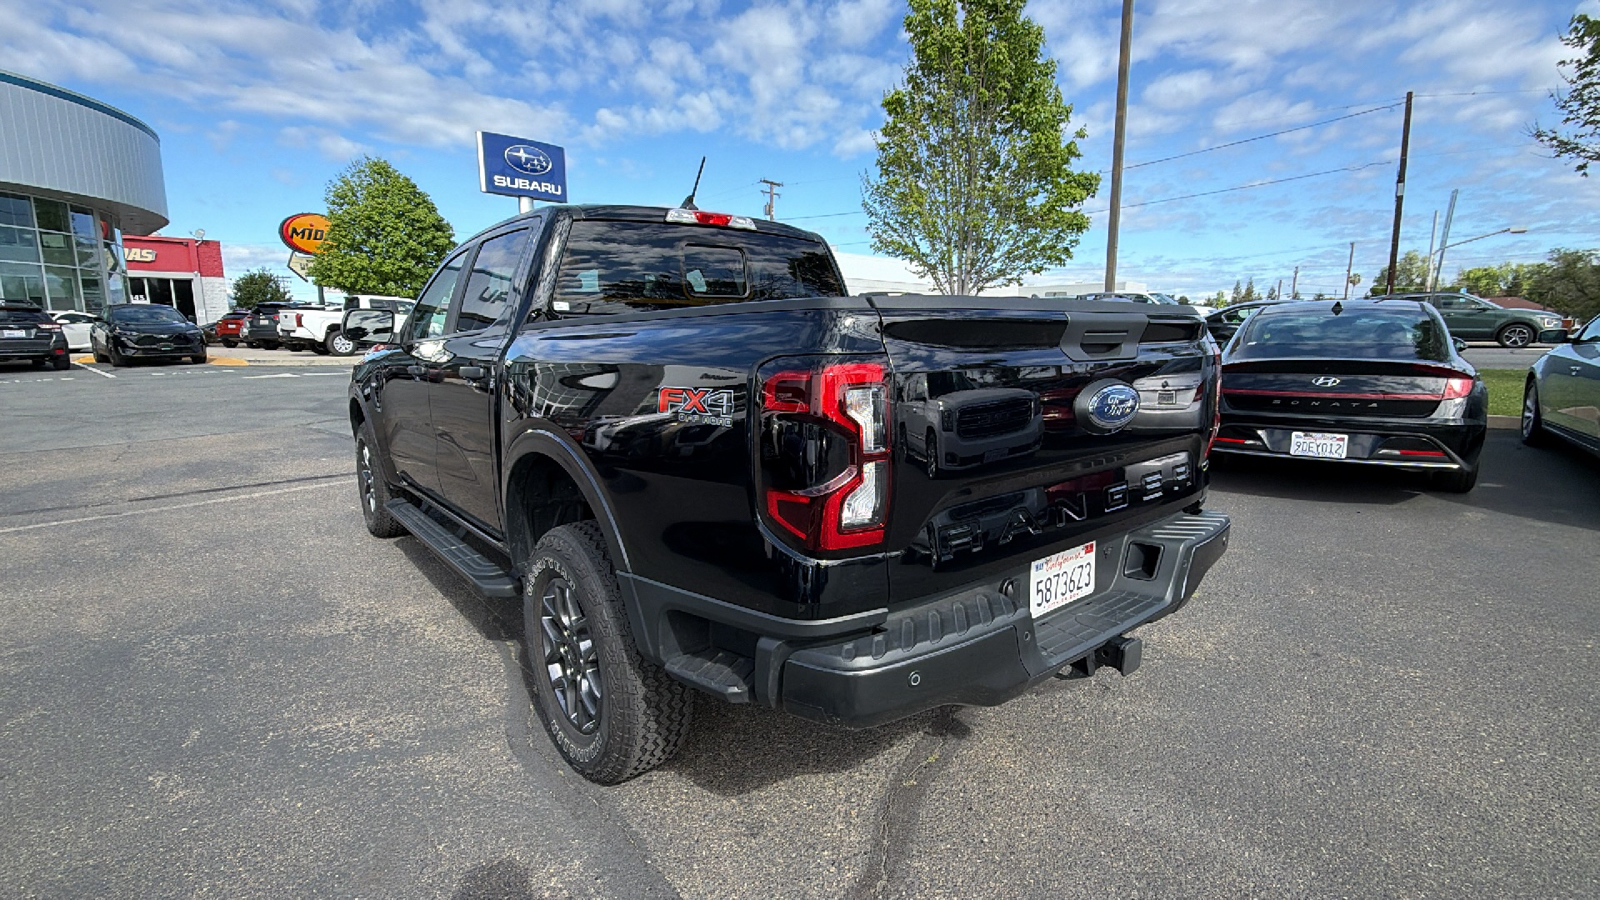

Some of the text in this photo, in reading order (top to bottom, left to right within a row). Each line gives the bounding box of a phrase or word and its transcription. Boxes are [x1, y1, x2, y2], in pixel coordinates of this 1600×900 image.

[493, 175, 562, 196] SUBARU
[290, 227, 326, 241] MID
[657, 385, 734, 417] FX4
[1272, 399, 1378, 407] SONATA
[678, 413, 734, 427] OFF ROAD
[938, 463, 1192, 562] RANGER
